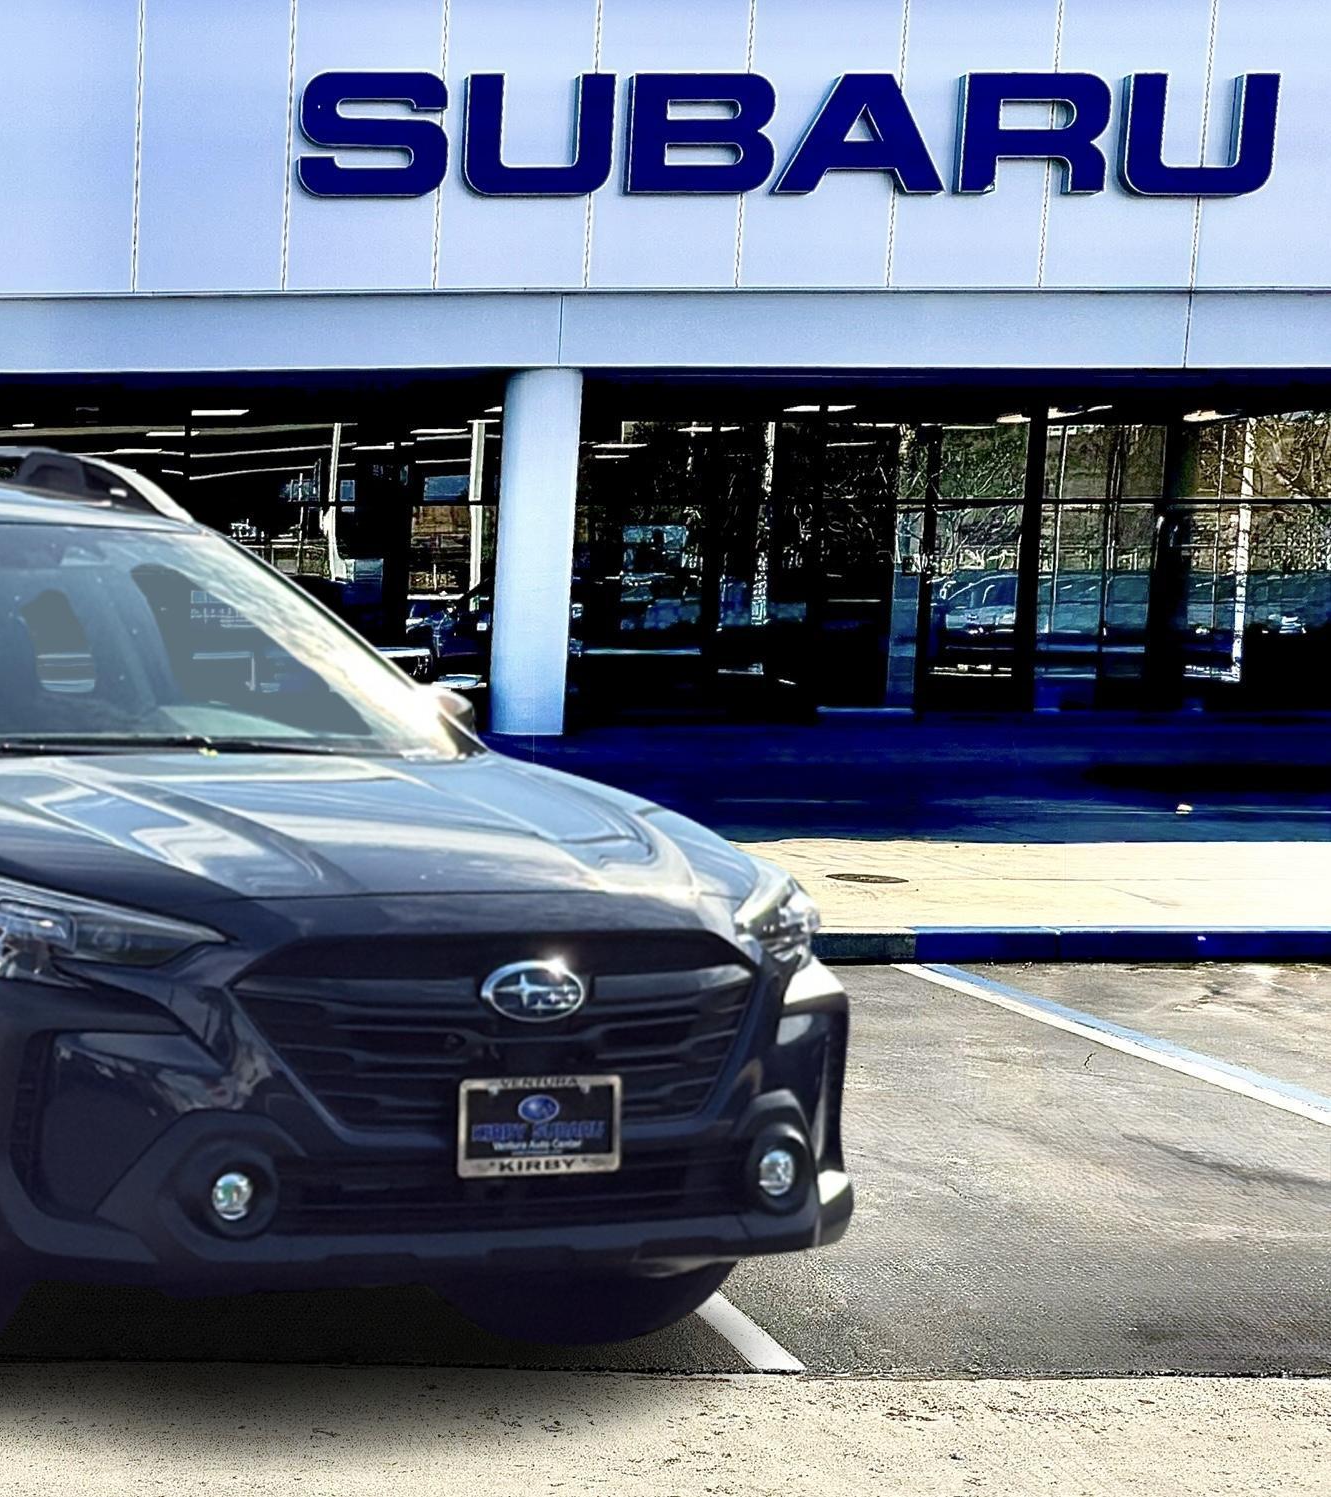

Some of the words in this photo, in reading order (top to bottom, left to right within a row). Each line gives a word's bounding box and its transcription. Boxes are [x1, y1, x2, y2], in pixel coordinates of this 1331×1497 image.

[297, 70, 1282, 198] SUBARU
[493, 1140, 527, 1150] Ventura
[528, 1140, 550, 1149] Auto
[552, 1138, 582, 1149] Center
[499, 1159, 576, 1173] KIRBY
